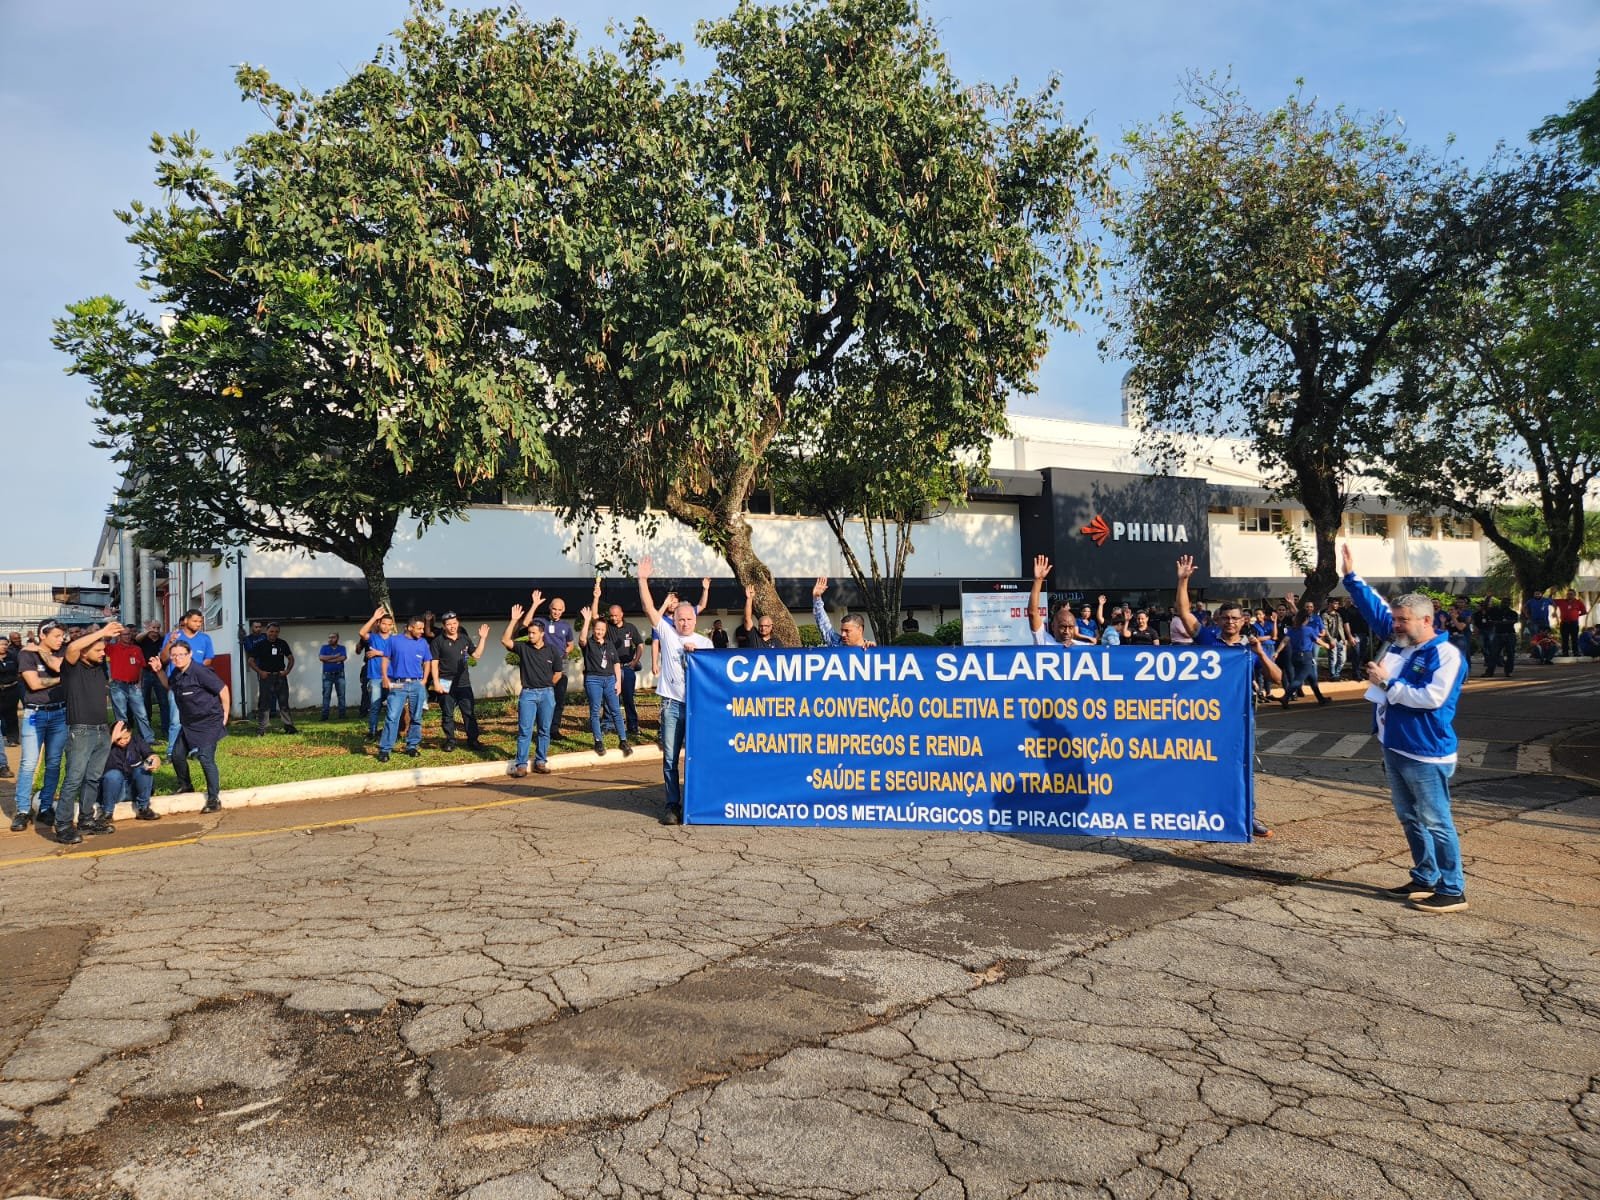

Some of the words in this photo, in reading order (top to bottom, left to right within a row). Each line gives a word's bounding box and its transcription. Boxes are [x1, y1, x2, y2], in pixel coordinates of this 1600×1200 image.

[1113, 521, 1188, 542] PHINIA
[726, 653, 924, 683] CAMPANHA
[935, 651, 1124, 682] SALARIAL
[1134, 650, 1222, 682] 2023
[731, 697, 796, 718] MANTER
[798, 697, 811, 718] A
[812, 693, 914, 723] CONVENÇÃO
[918, 697, 1000, 719] COLETIVA
[1003, 698, 1015, 719] E
[1018, 698, 1079, 720] TODOS
[1082, 698, 1108, 721] OS
[1113, 693, 1221, 721] BENEFÍCIOS
[733, 732, 814, 754] GARANTIR
[816, 733, 906, 756] EMPREGOS
[909, 734, 920, 756] E
[926, 735, 984, 757] RENDA
[1024, 732, 1124, 764] REPOSIÇÃO
[1128, 737, 1218, 761] SALARIAL
[811, 762, 866, 791] SAÚDE
[870, 769, 881, 791] E
[885, 770, 988, 797] SEGURANÇA
[990, 772, 1015, 794] NO
[1018, 772, 1113, 796] TRABALHO
[724, 802, 809, 819] SINDICATO
[813, 804, 848, 820] DOS
[851, 802, 984, 825] METALÚRGICOS
[988, 809, 1012, 826] DE
[1017, 810, 1128, 830] PIRACICABA
[1133, 813, 1146, 830] E
[1150, 810, 1225, 832] REGIÃO
